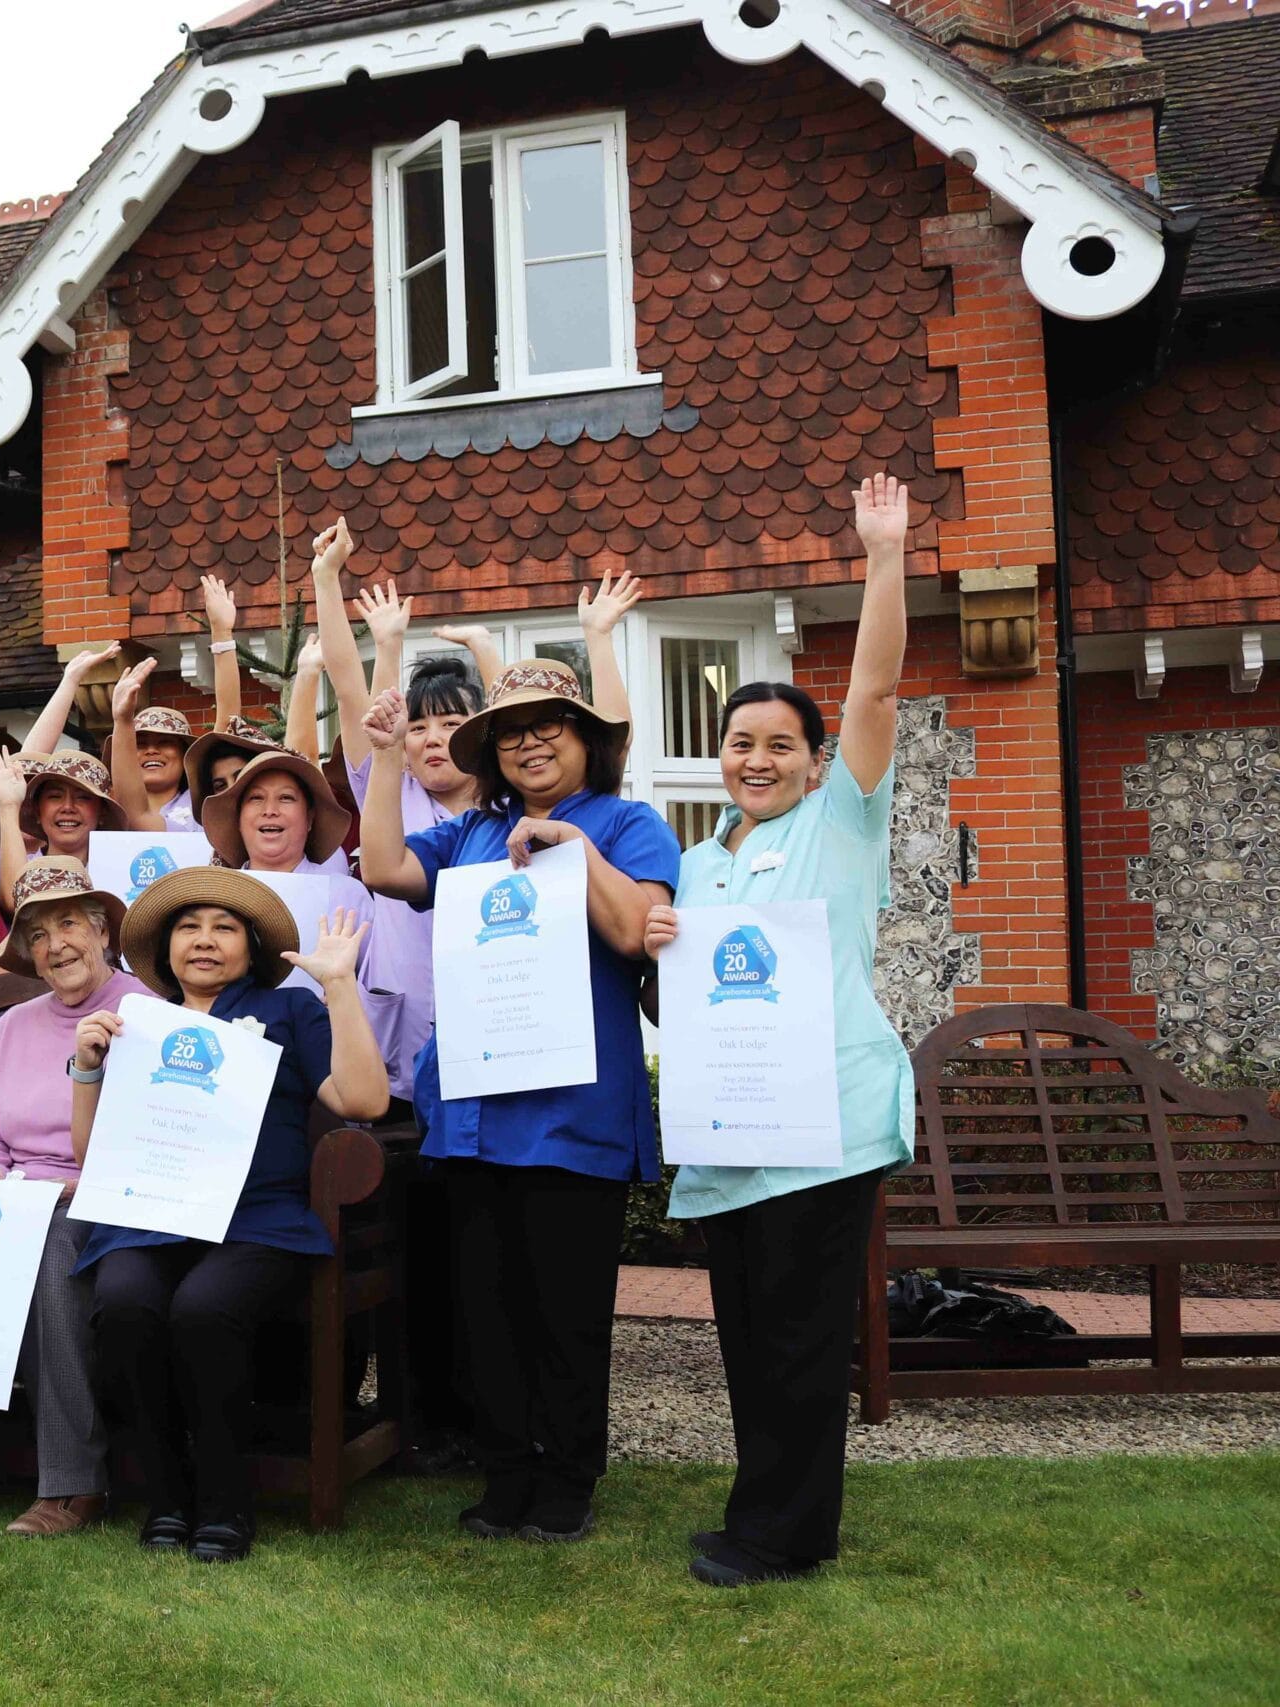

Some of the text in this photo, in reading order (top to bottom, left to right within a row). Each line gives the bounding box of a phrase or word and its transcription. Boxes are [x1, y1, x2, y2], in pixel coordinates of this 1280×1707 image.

[139, 858, 156, 866] TOP
[138, 865, 156, 878] 20
[491, 887, 512, 898] TOP
[490, 896, 510, 914] 20
[487, 909, 522, 924] AWARD
[723, 943, 746, 953] TOP
[752, 936, 770, 957] 2024
[724, 953, 747, 972] 20
[722, 971, 760, 982] AWARD
[176, 1033, 199, 1045] TOP
[719, 1039, 768, 1050] Oak Lodge
[171, 1041, 196, 1060] 20
[167, 1056, 204, 1071] AWARD
[723, 1122, 782, 1130] carehome.co.uk
